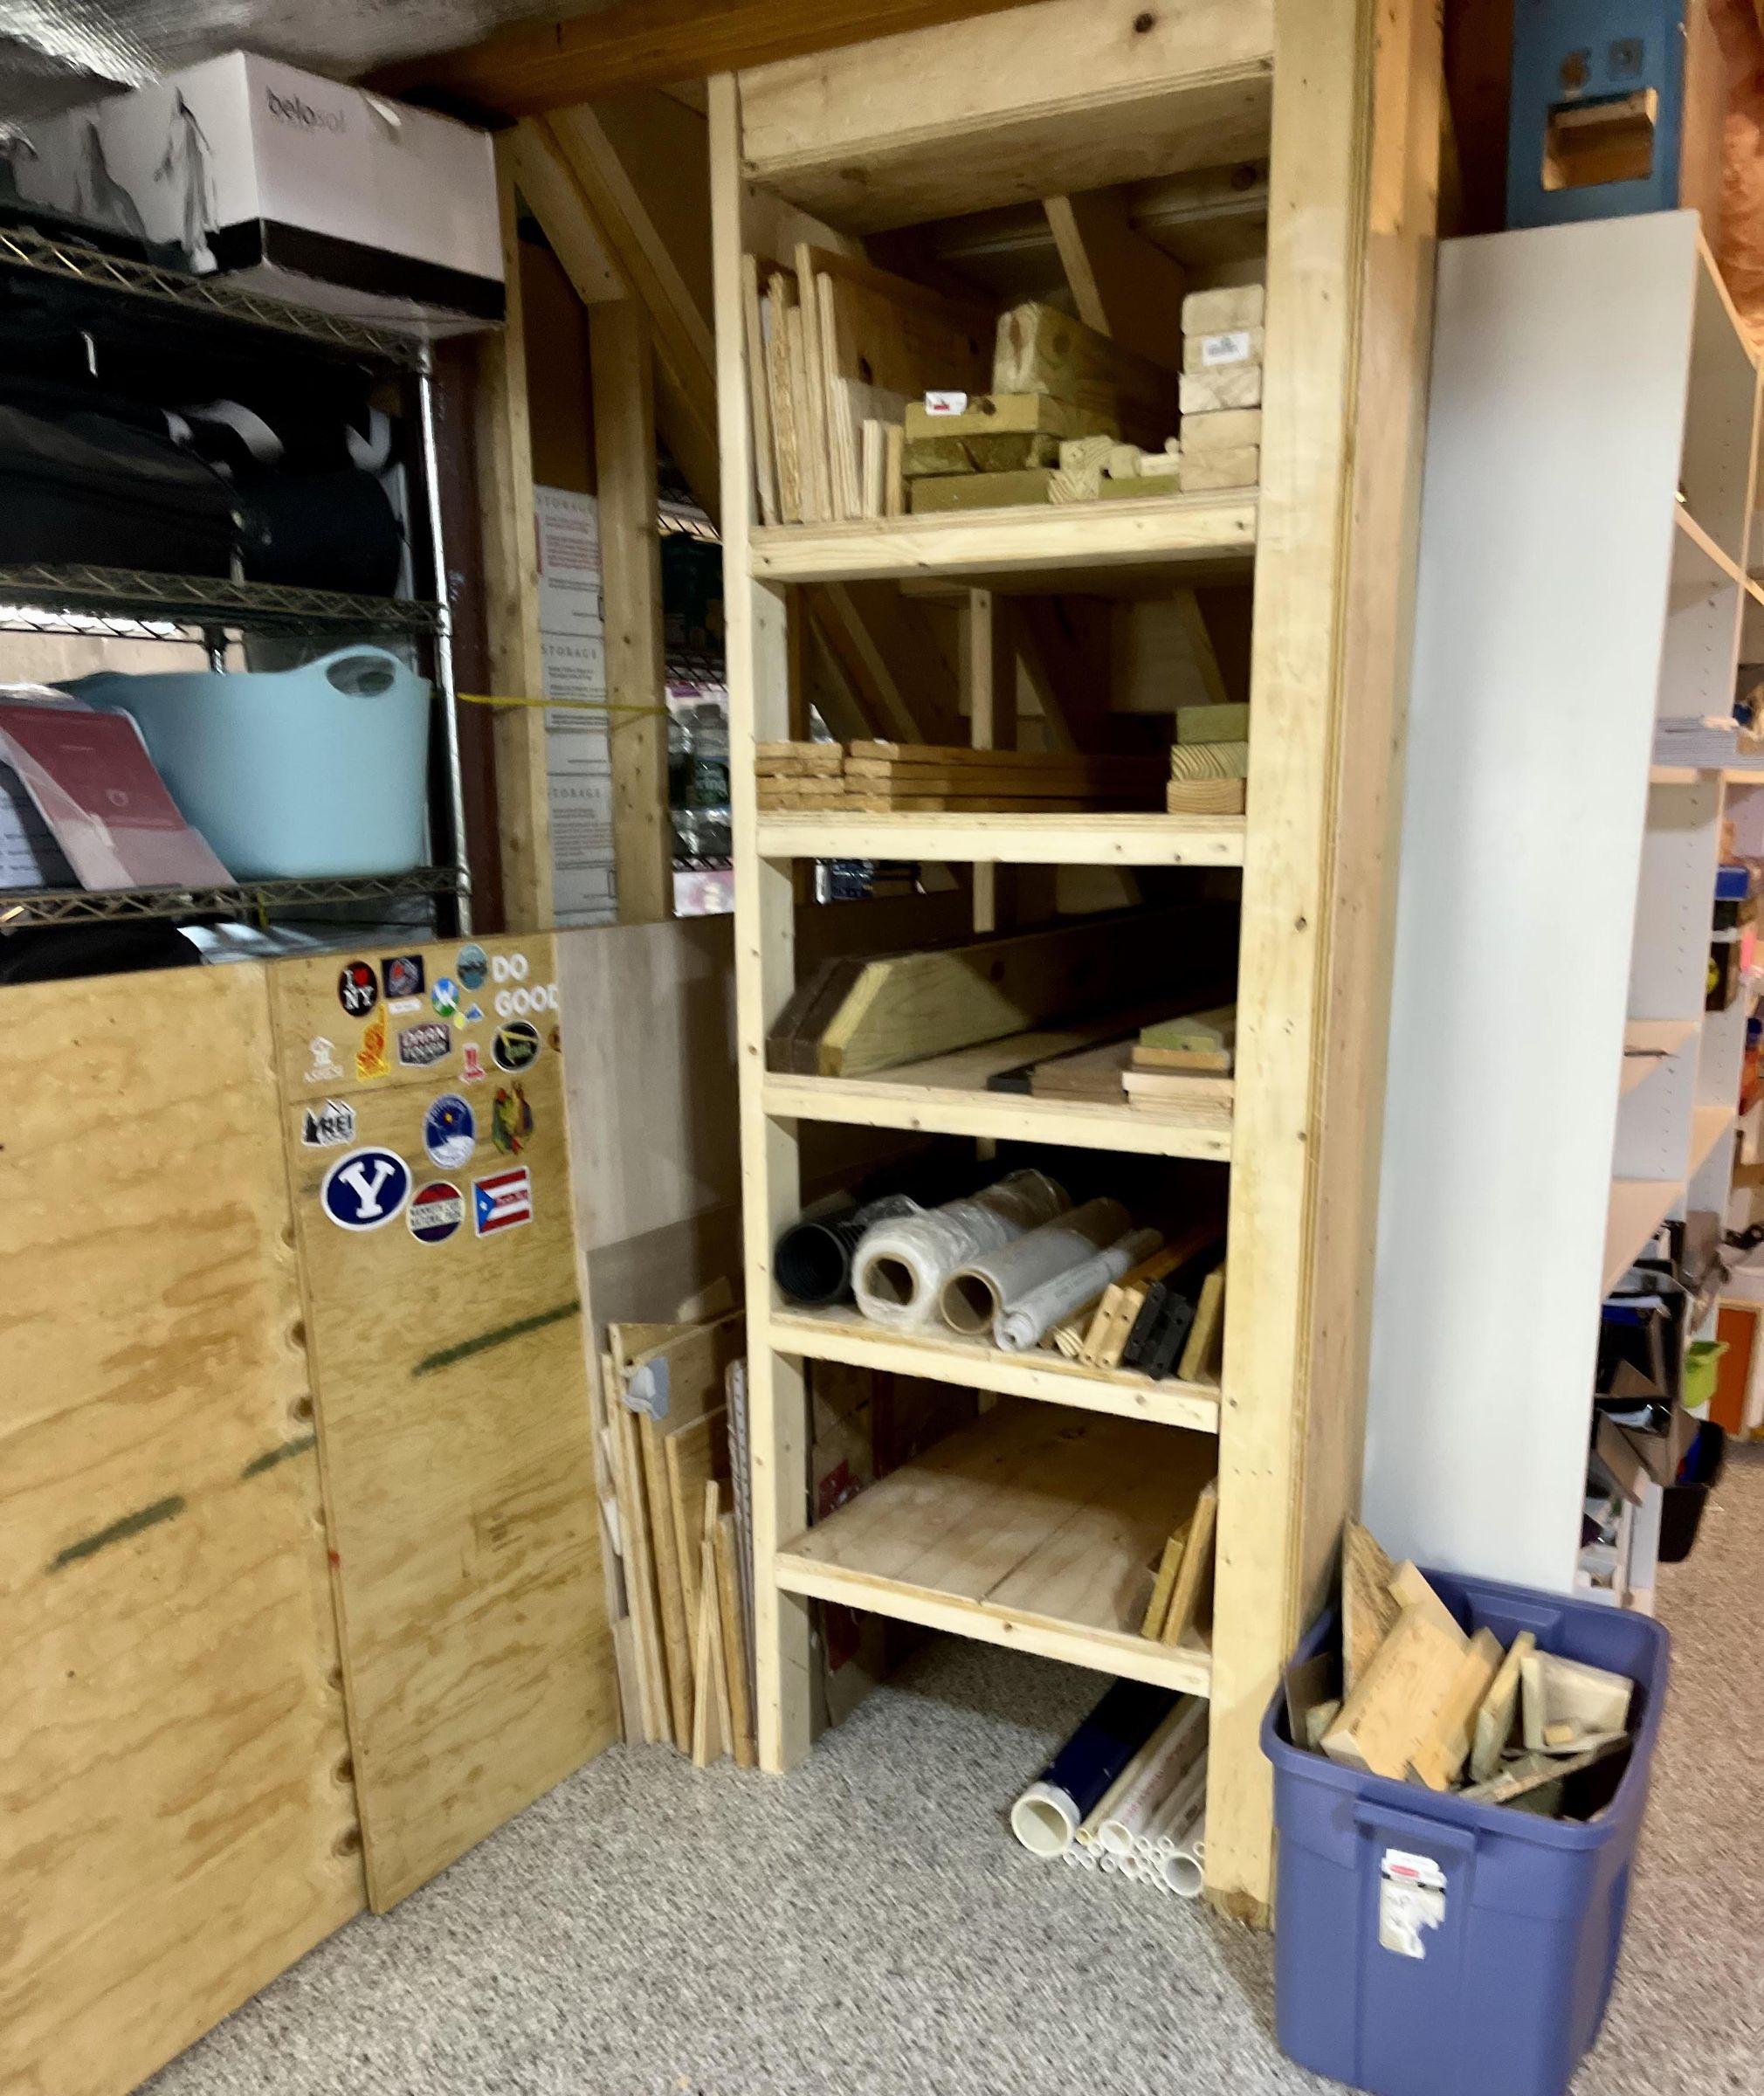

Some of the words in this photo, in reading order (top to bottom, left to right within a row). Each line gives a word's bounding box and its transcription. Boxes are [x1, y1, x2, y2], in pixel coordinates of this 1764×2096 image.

[541, 643, 596, 659] STORAGE
[492, 953, 528, 982] DO
[342, 985, 375, 1010] NY
[319, 1114, 353, 1134] REI
[337, 1159, 396, 1219] Y
